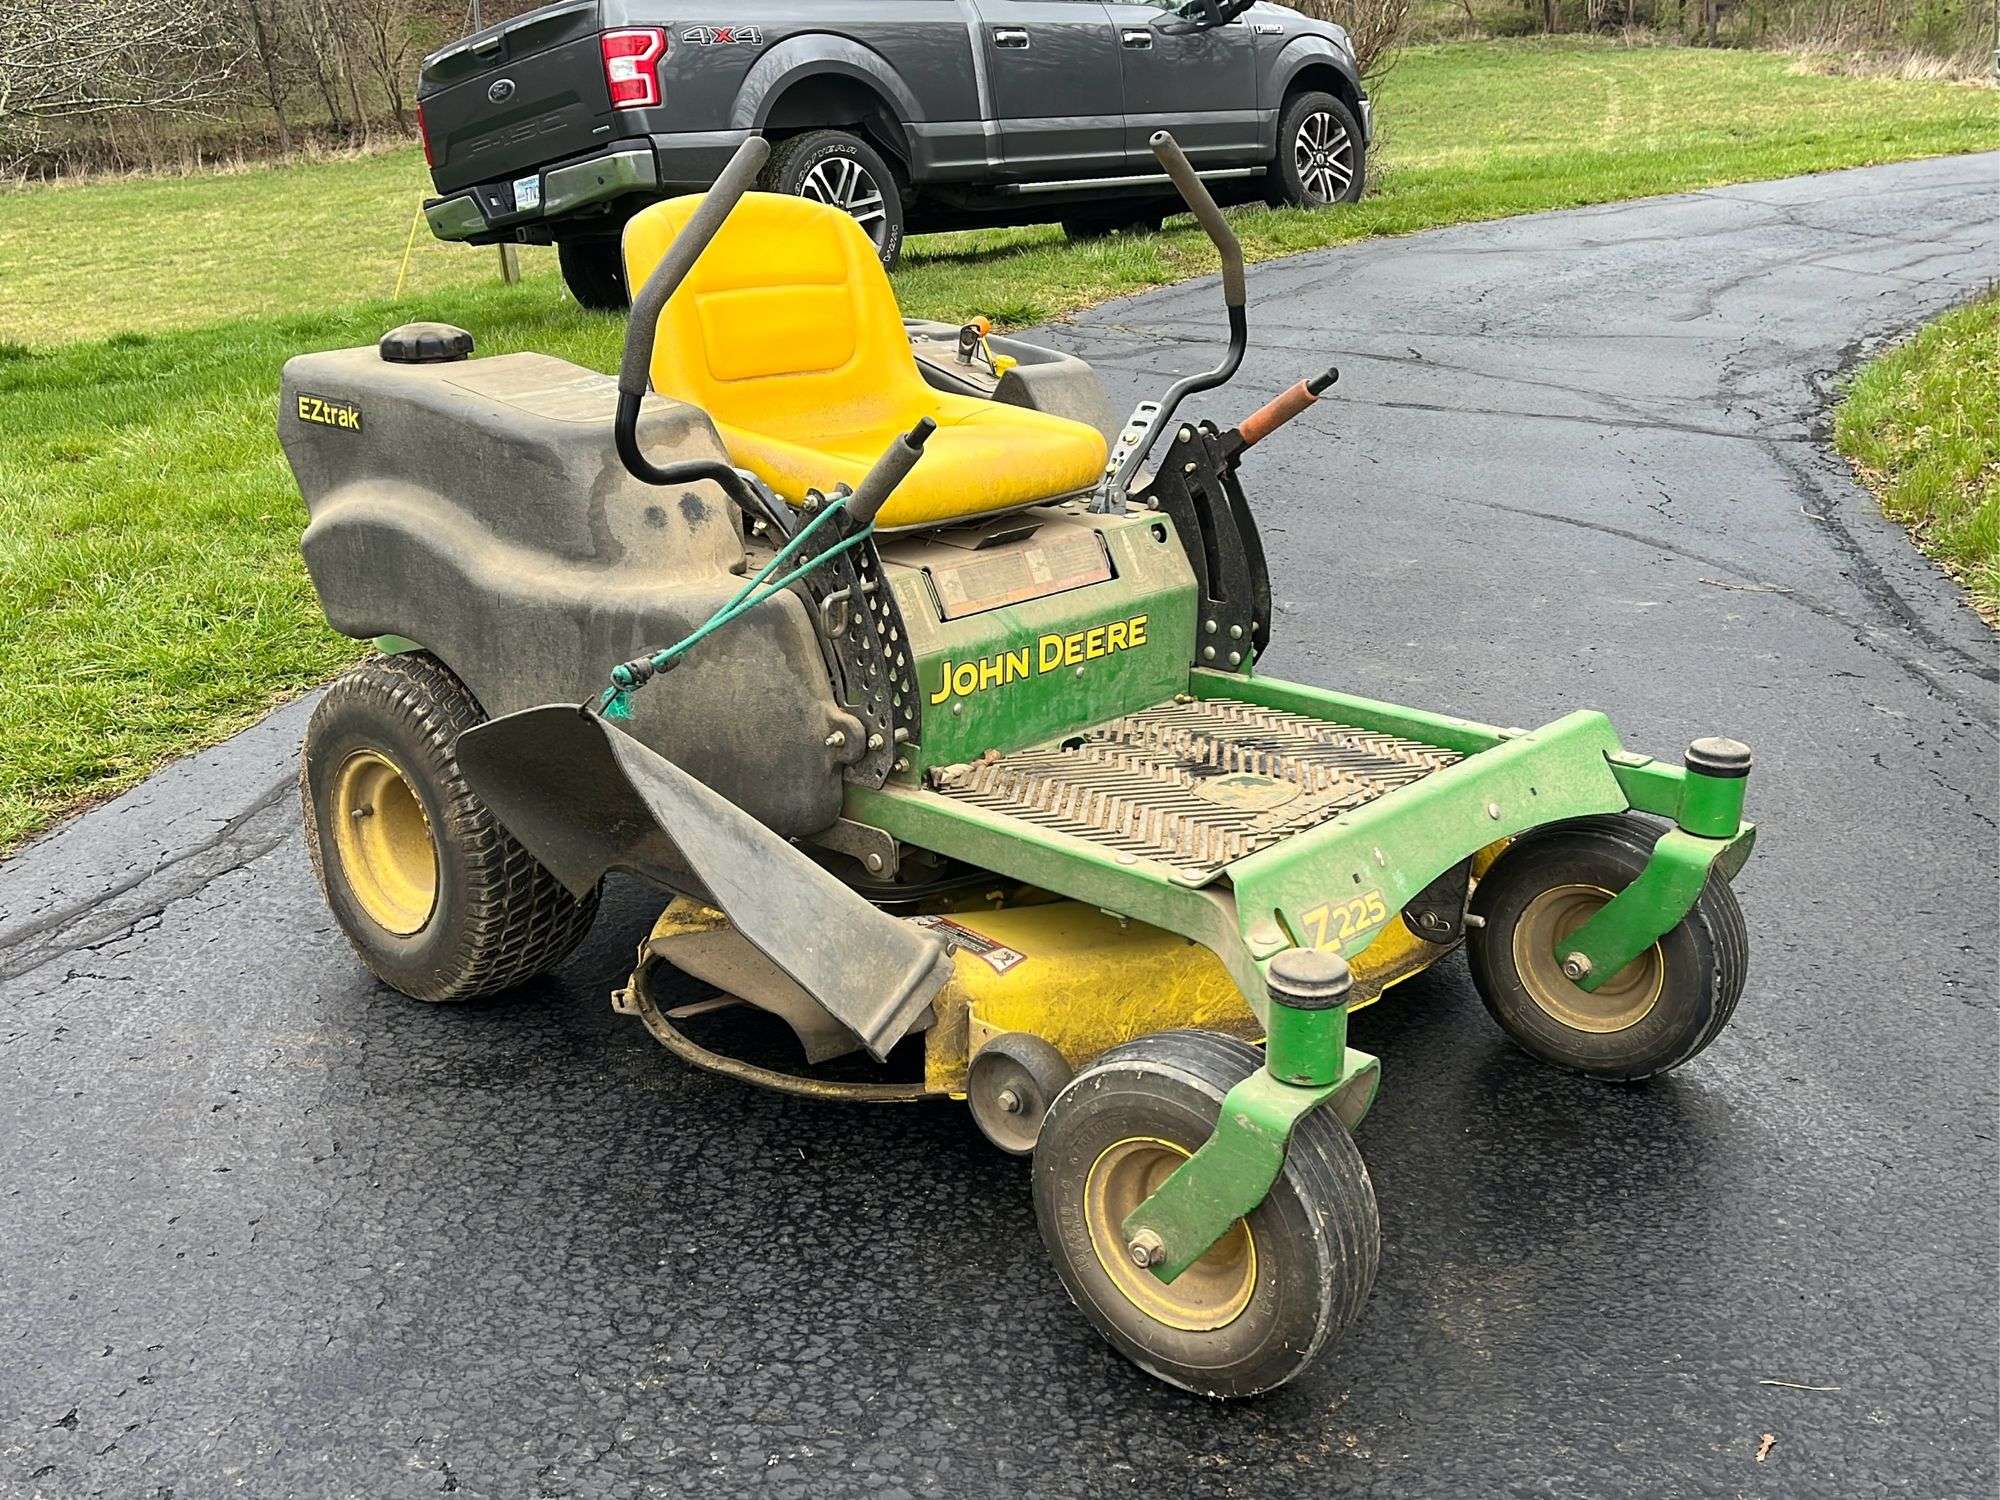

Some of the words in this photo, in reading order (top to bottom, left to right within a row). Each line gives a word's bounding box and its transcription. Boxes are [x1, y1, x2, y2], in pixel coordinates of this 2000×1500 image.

[298, 396, 360, 430] EZtrak
[930, 646, 1031, 705] JOHN
[1038, 614, 1148, 675] DEERE
[1301, 889, 1387, 953] Z225
